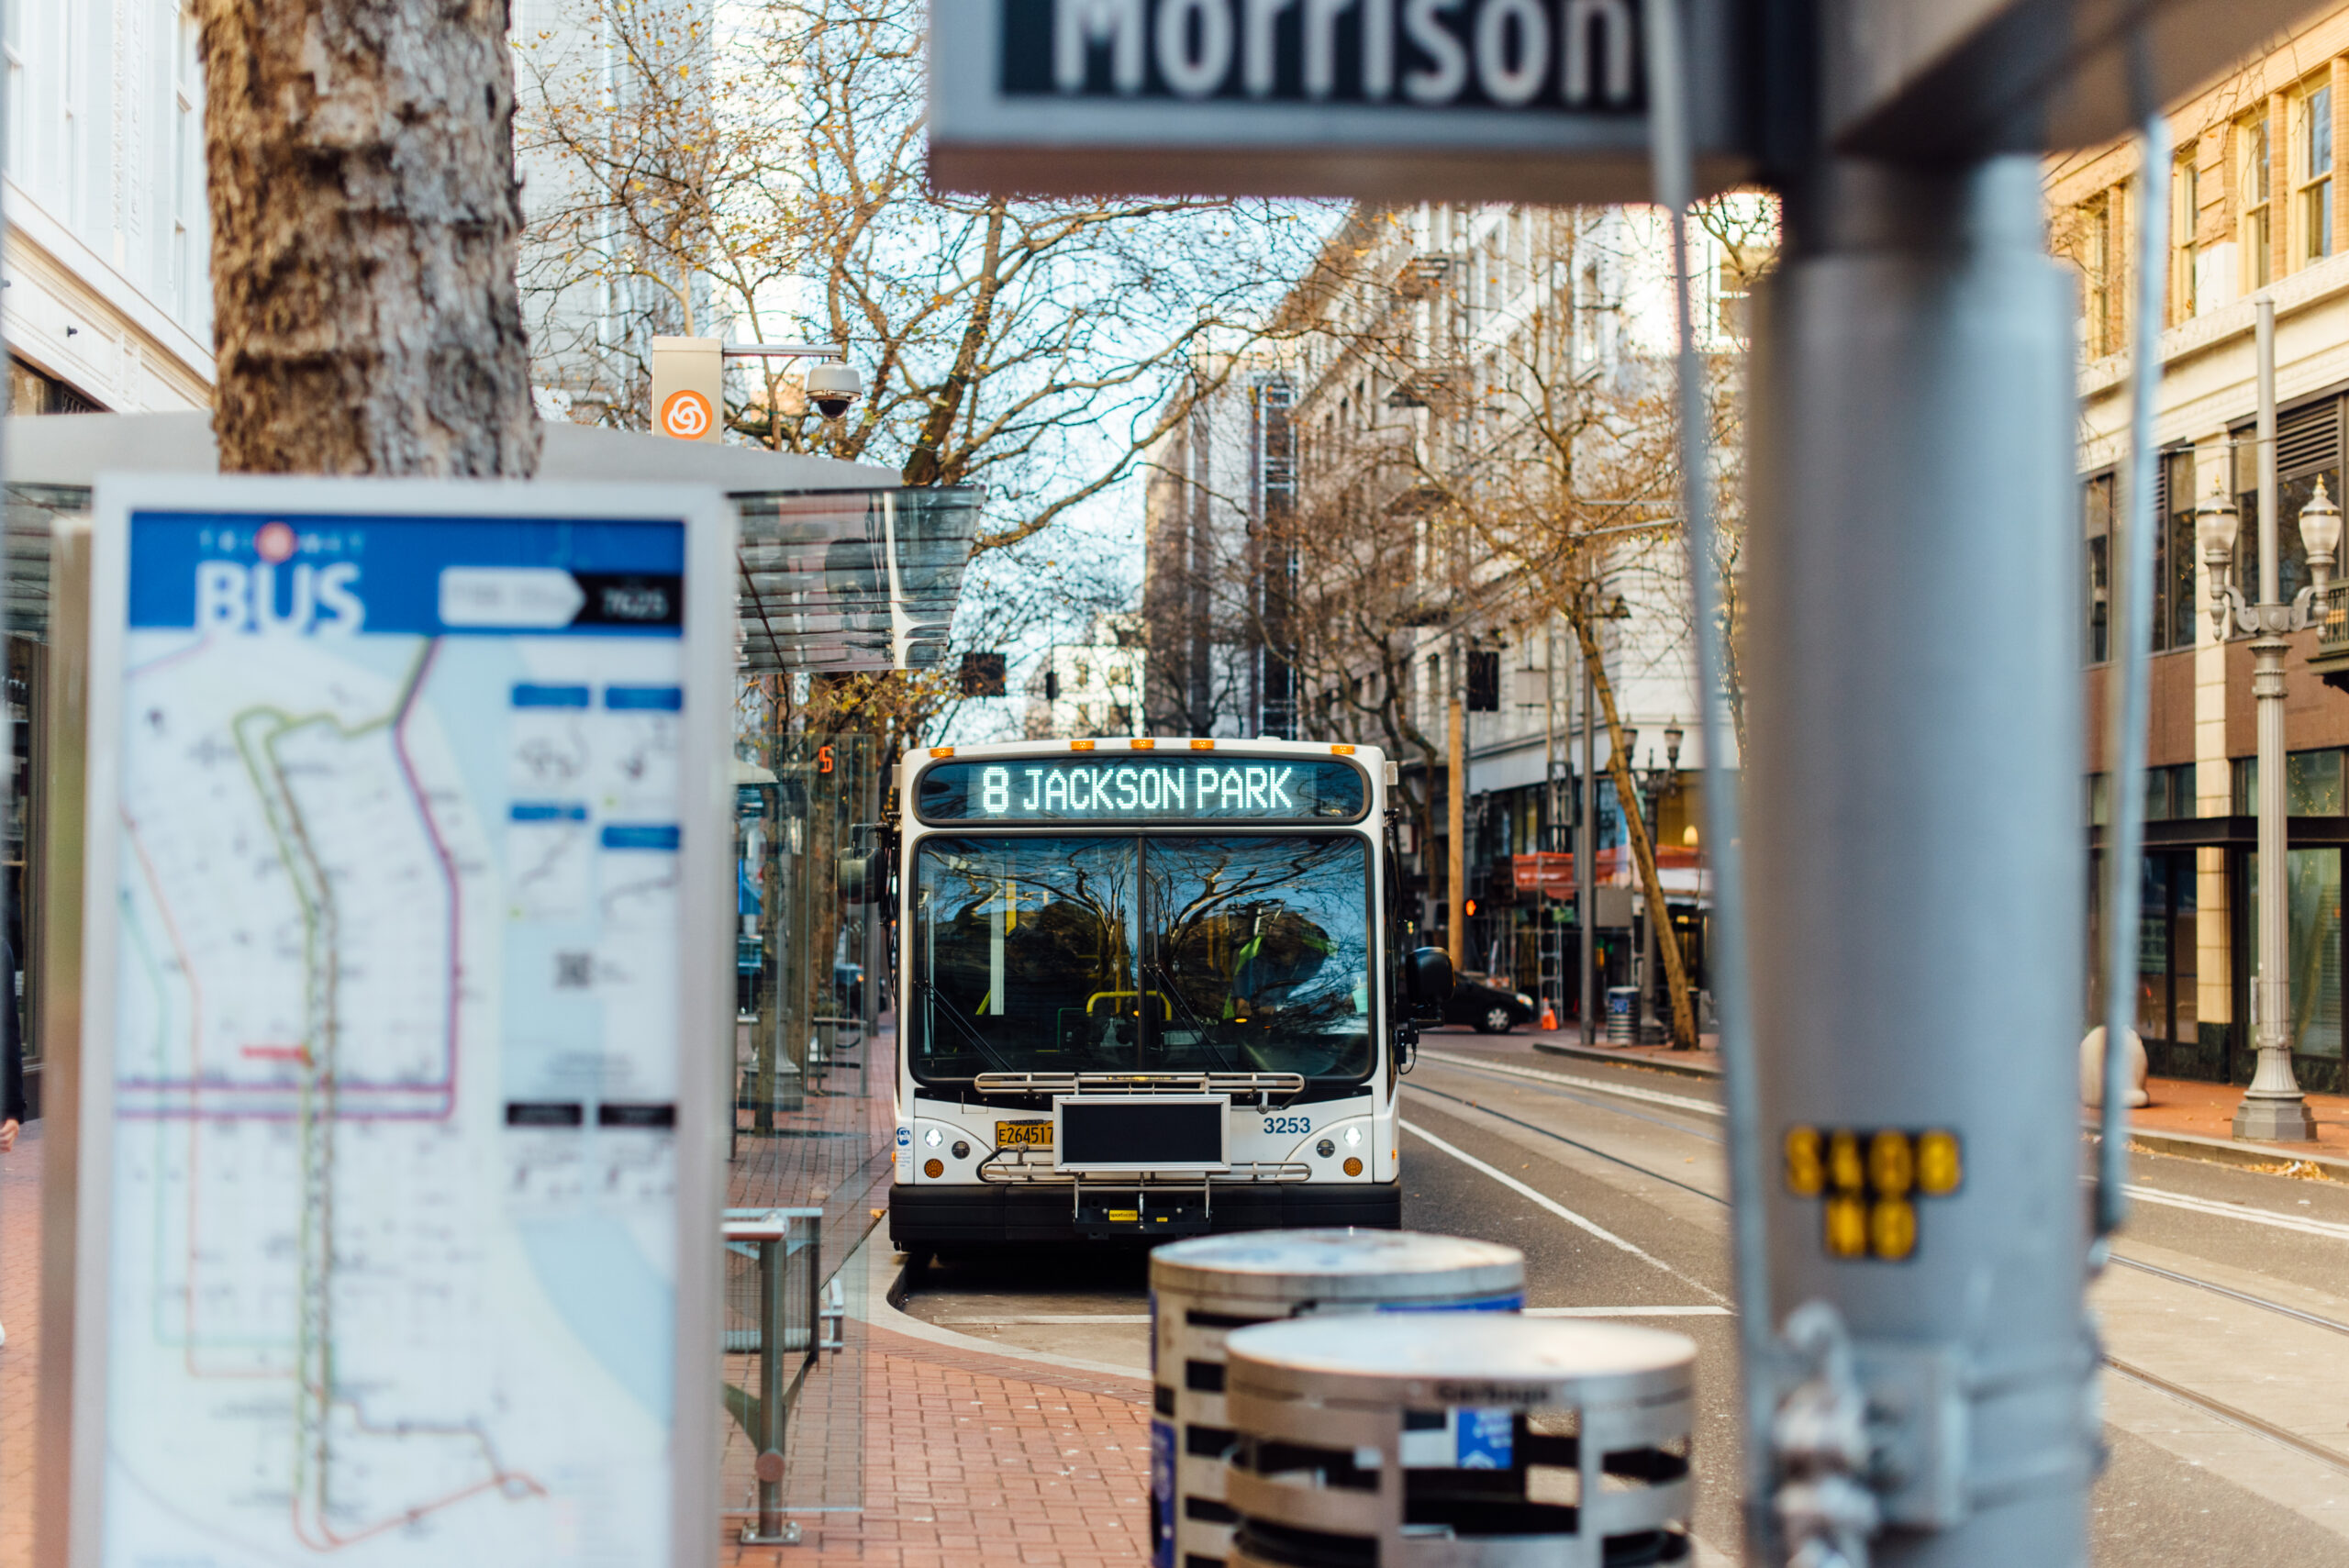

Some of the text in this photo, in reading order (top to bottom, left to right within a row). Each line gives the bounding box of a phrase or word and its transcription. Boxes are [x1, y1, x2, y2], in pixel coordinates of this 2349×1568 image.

[1052, 0, 1631, 102] Morrison
[195, 560, 366, 635] BUS
[983, 766, 1293, 813] 8 JACKSON PARK
[998, 1127, 1053, 1143] E264517
[1264, 1117, 1311, 1134] 3253
